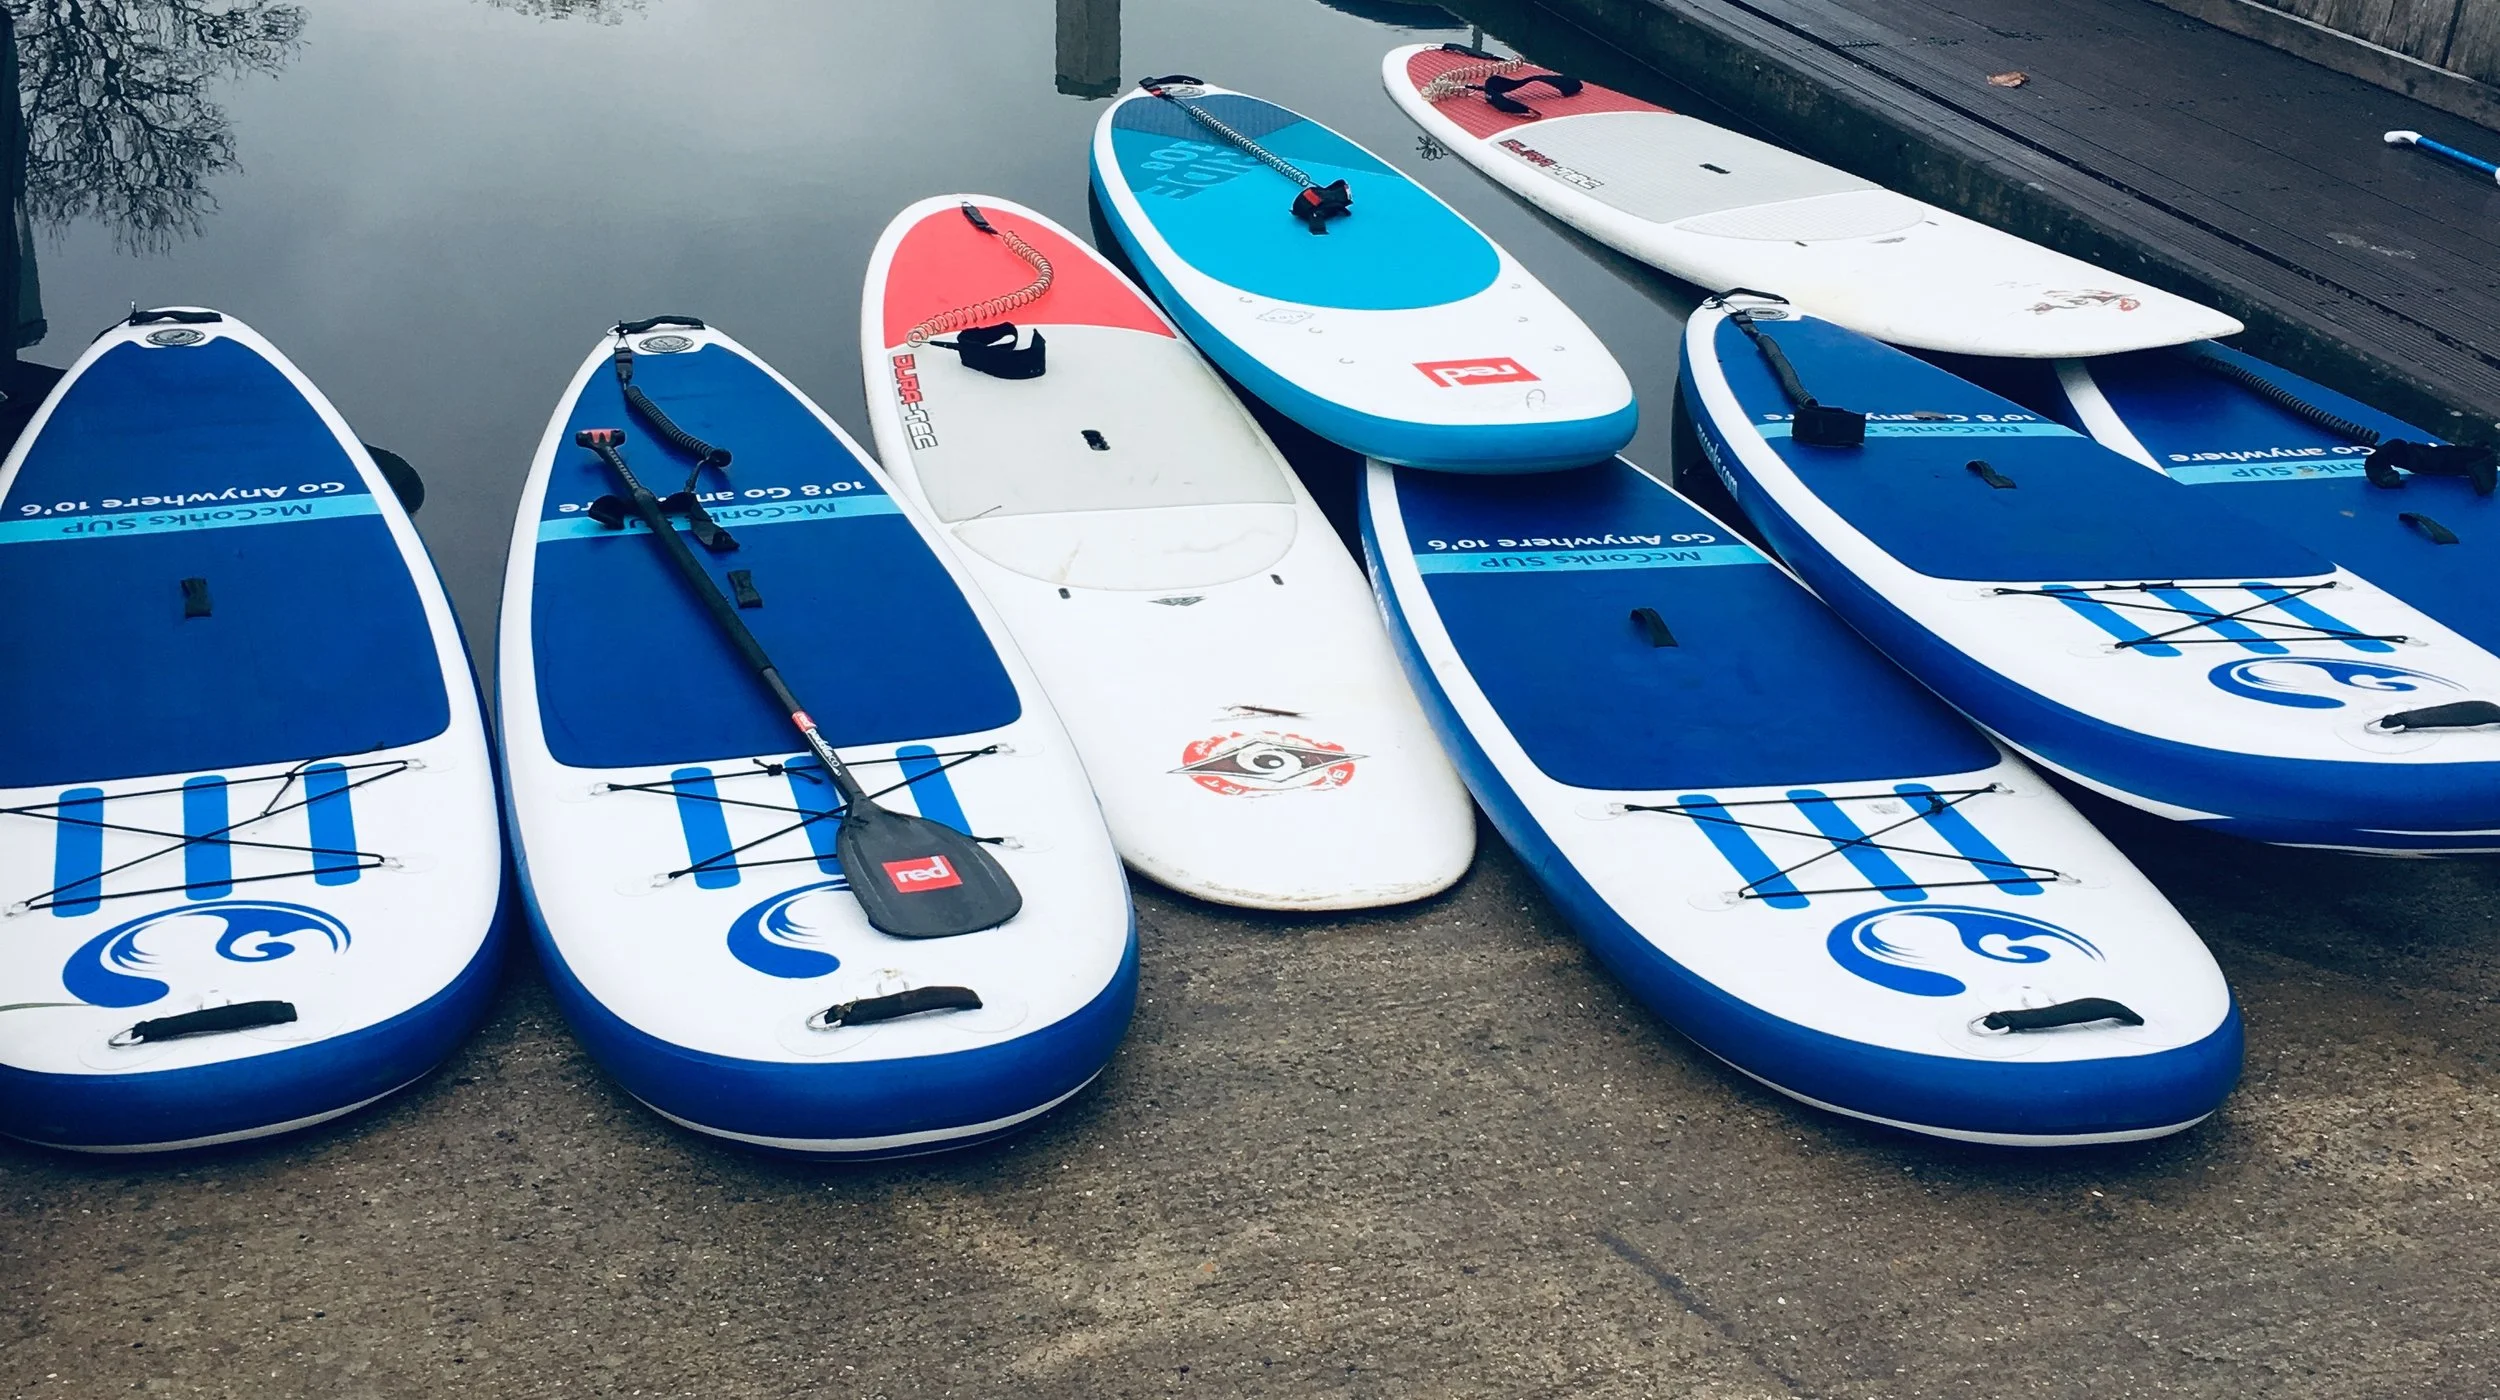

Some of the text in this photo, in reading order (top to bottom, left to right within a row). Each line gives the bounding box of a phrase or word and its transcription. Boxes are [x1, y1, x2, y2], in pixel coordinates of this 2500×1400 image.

[1432, 364, 1520, 388] red
[893, 354, 938, 450] DURA-TEC
[1975, 414, 2036, 422] 10'8
[1883, 426, 2022, 434] McConks
[2168, 446, 2376, 462] Go anywhere
[2231, 466, 2293, 478] SUP
[744, 487, 791, 499] Go
[800, 481, 866, 496] 10'8
[20, 482, 345, 516] Go Anywhere 10'6
[62, 504, 312, 533] McConks SUP
[1427, 533, 1716, 550] Go Anywhere 10'6
[1481, 551, 1702, 568] McConks SUP
[896, 855, 950, 884] red
